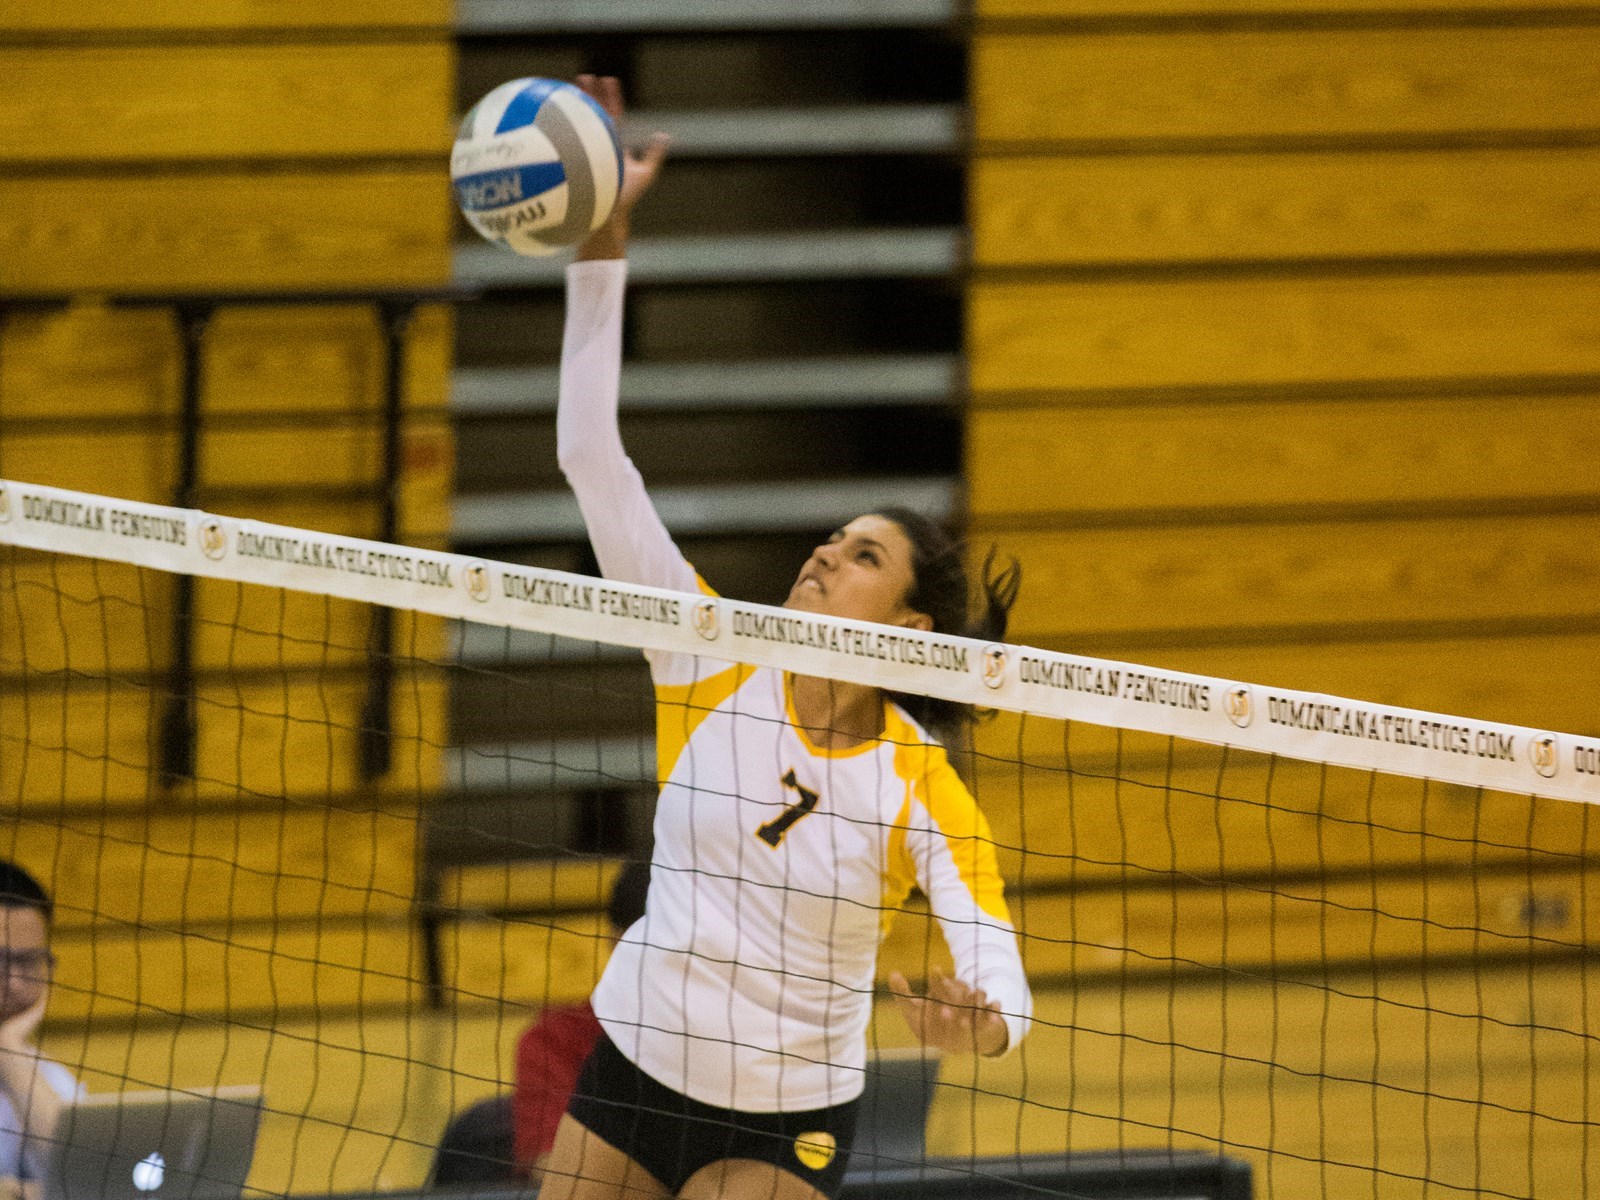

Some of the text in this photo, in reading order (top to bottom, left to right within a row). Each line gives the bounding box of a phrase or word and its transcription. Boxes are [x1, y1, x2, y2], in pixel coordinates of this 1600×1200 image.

[22, 494, 187, 546] DOMINICAN PENGUINS
[236, 531, 454, 588] DOMINICANATHLETICS.COM
[502, 573, 681, 625] DOMINICAN PENGUINS
[733, 610, 970, 673] DOMINICANATHLETICS.COM
[1019, 656, 1210, 712] DOMINICAN PENGUINS
[1268, 696, 1515, 762] DOMINICANATHLETICS.COM
[1574, 745, 1600, 776] DO
[755, 767, 819, 850] 7
